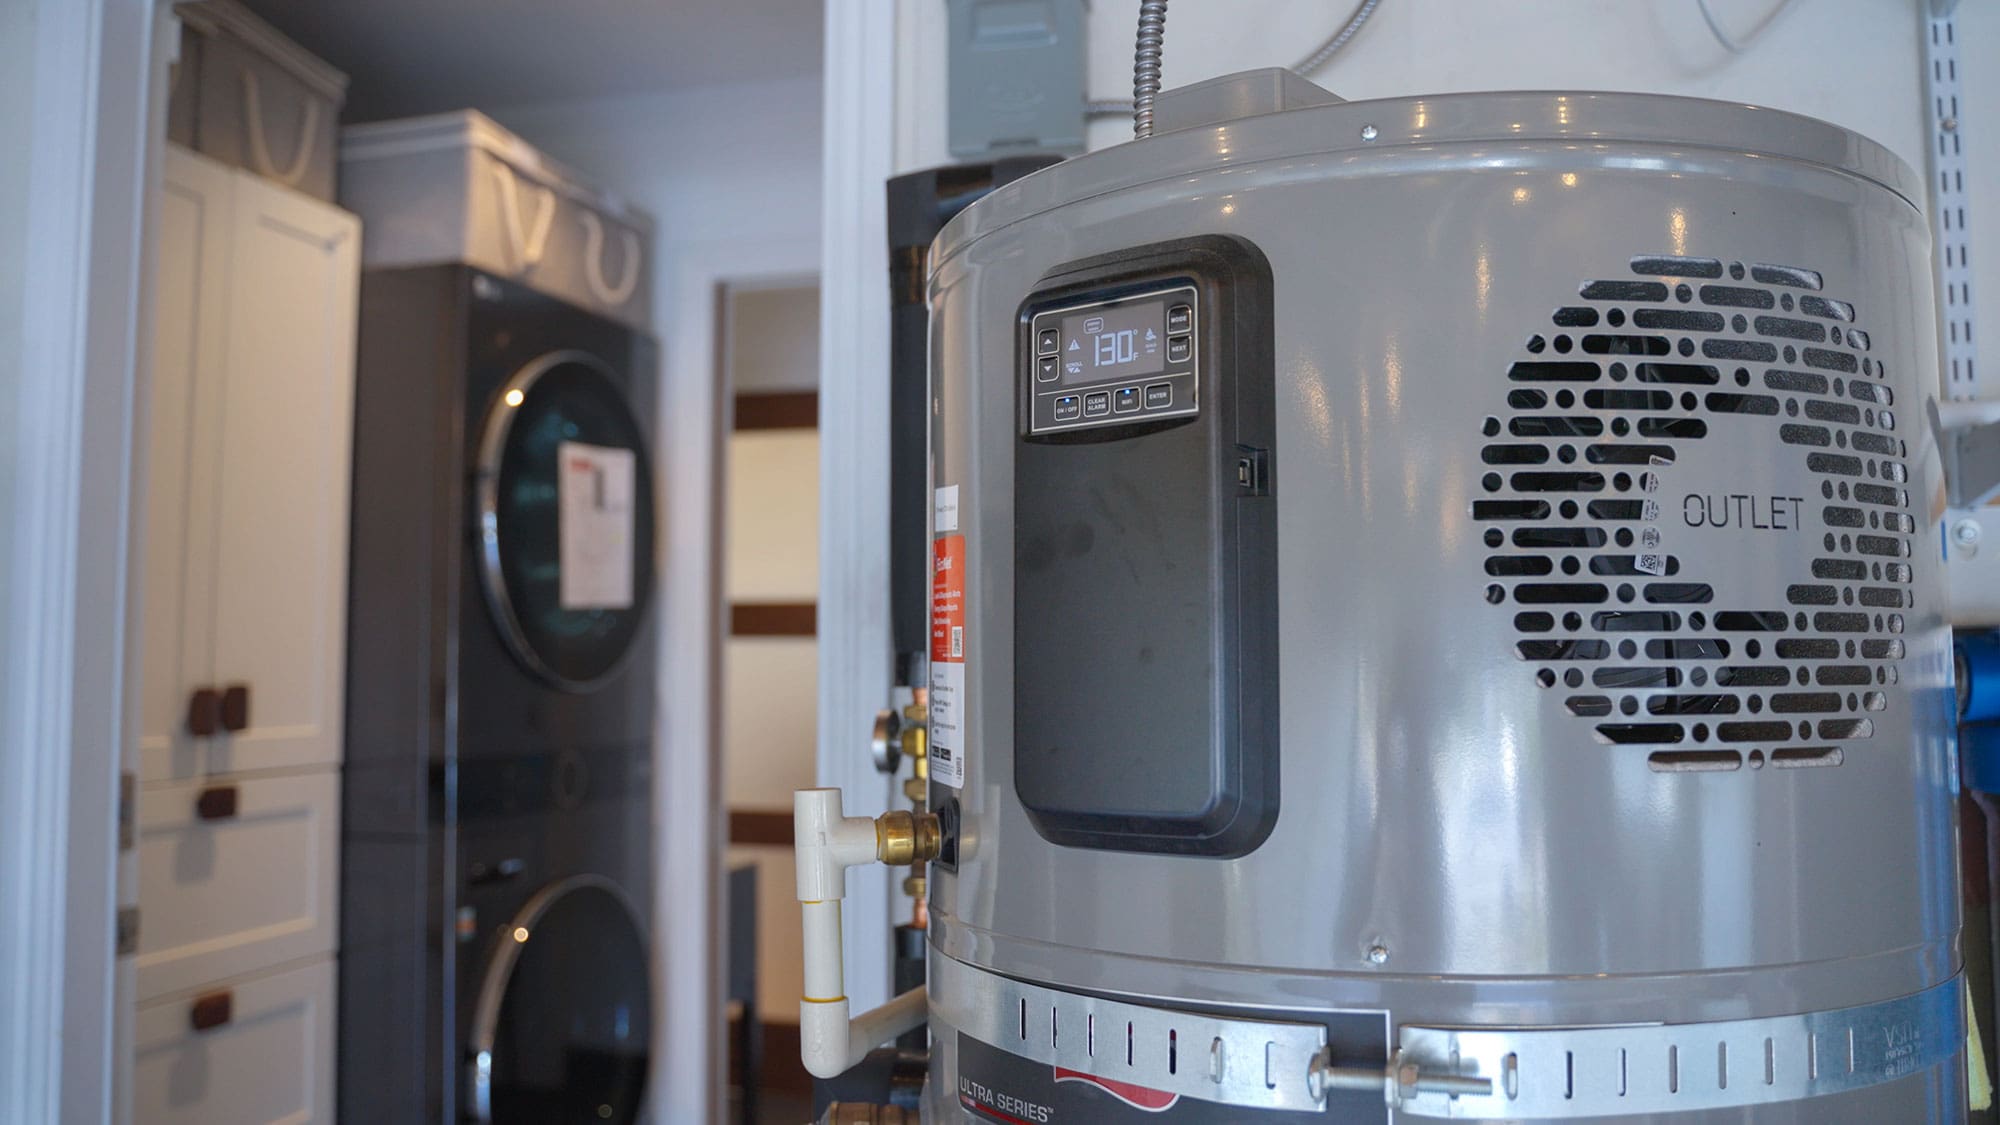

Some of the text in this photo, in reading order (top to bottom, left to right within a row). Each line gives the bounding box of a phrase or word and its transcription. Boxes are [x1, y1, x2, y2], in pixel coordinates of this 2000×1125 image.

[1171, 315, 1187, 323] MODE
[1171, 344, 1187, 352] NEXT
[1149, 392, 1167, 400] ENTER
[1087, 397, 1106, 405] CLEAR
[1087, 403, 1106, 411] ALARM
[1684, 494, 1804, 531] OUTLET
[960, 1076, 994, 1105] ULTRA
